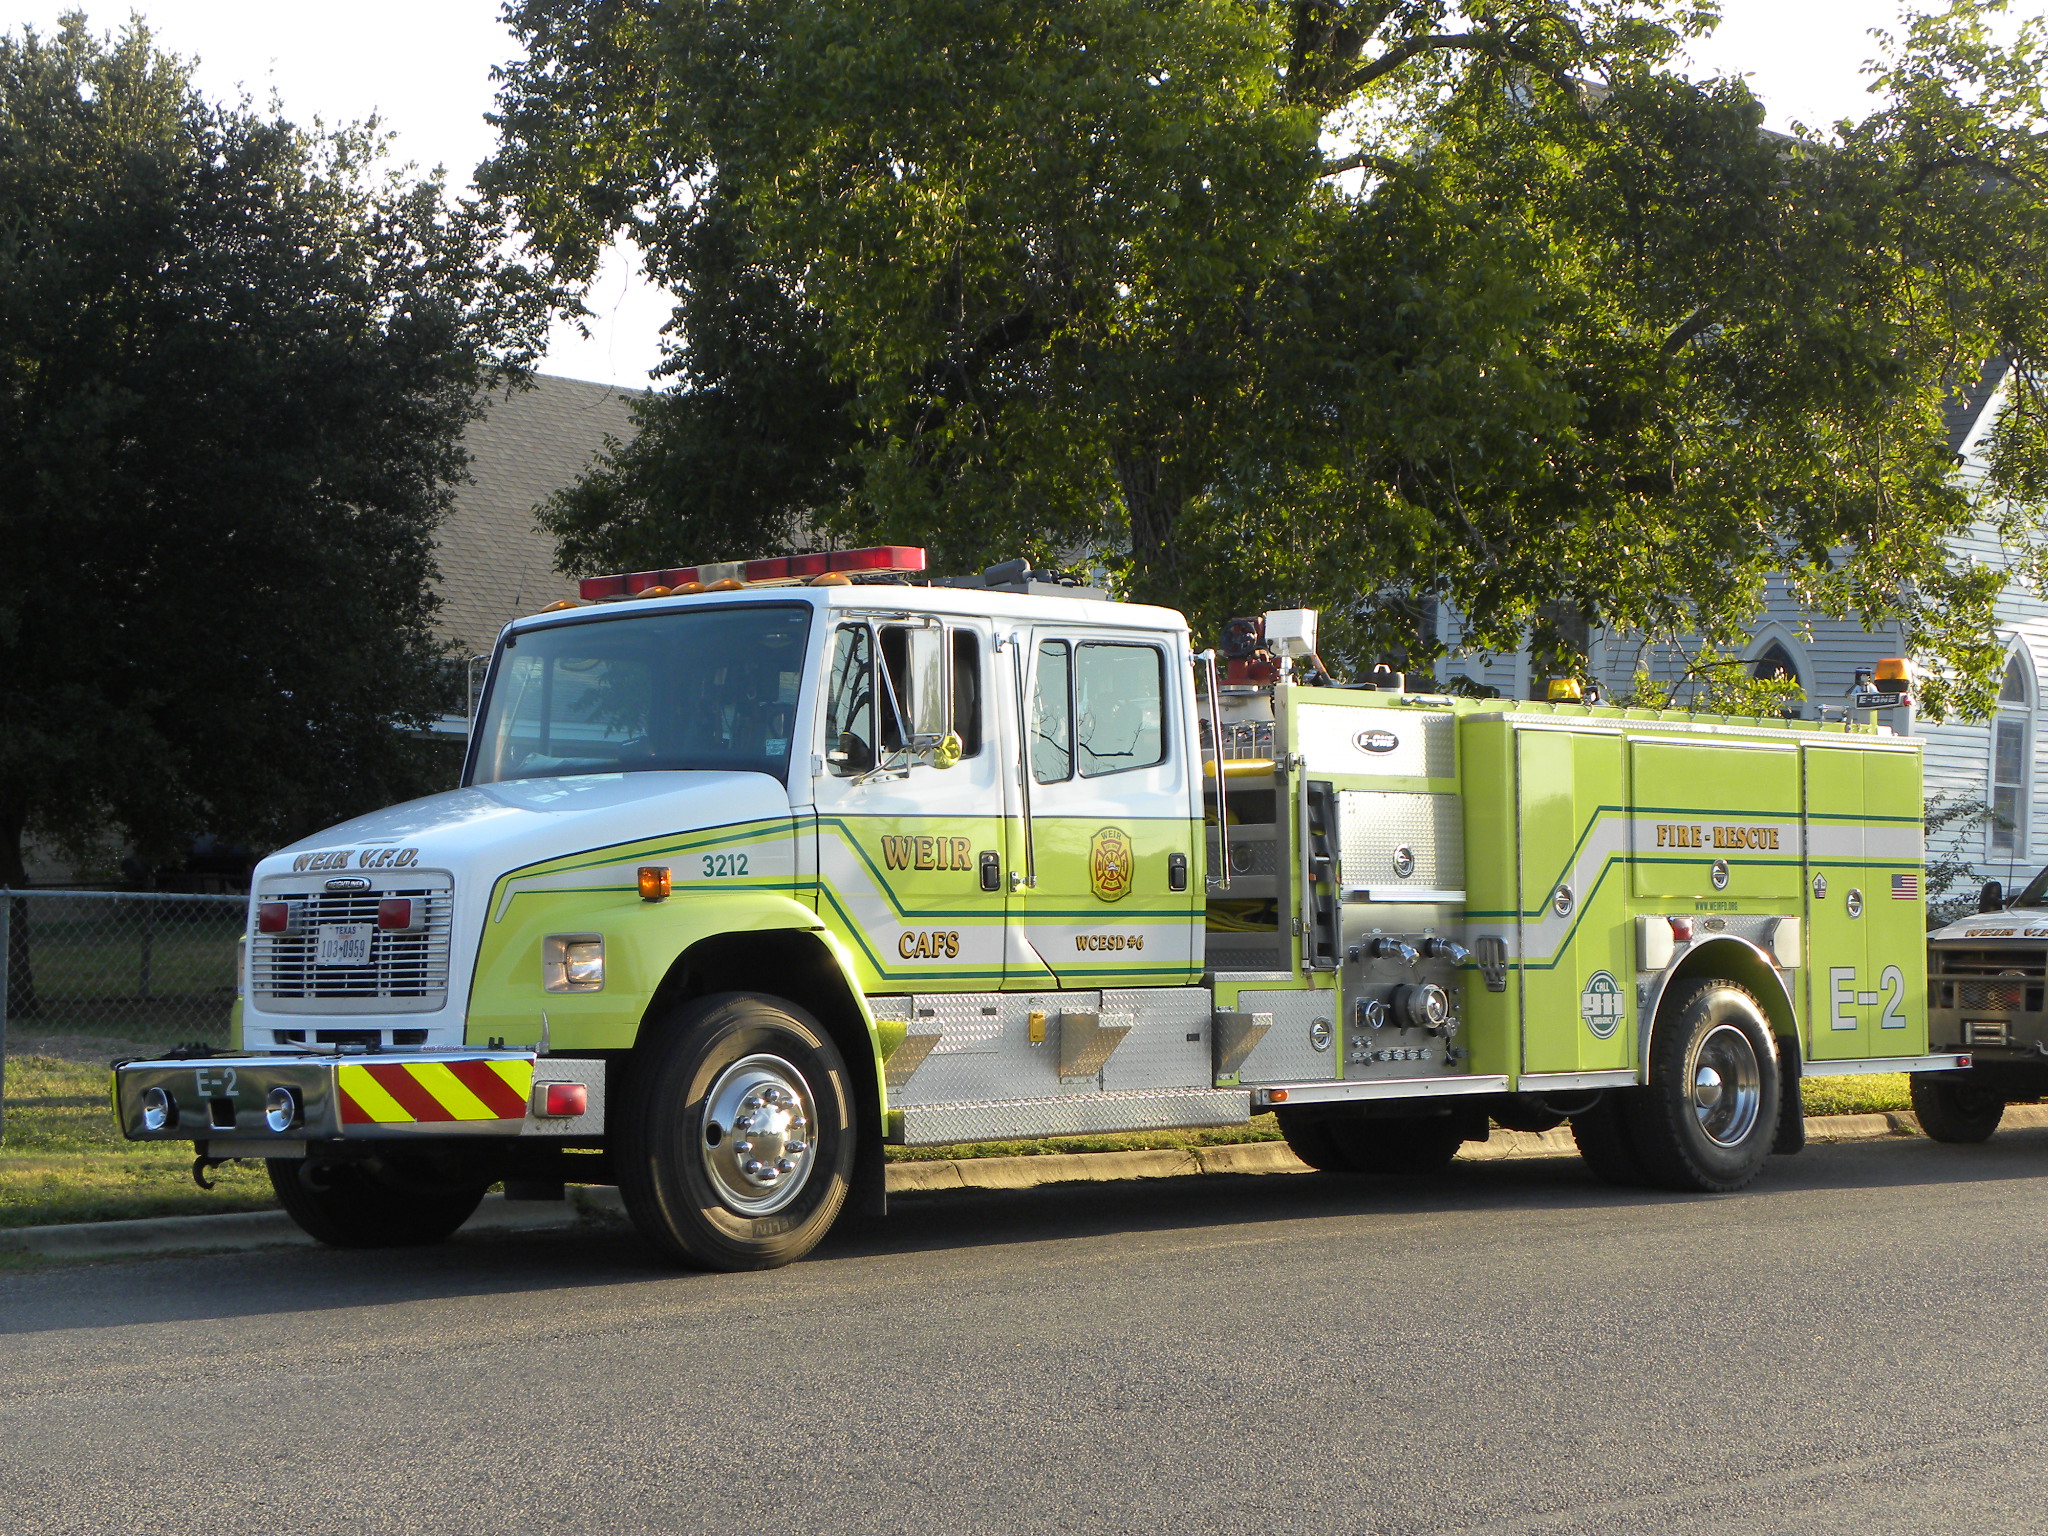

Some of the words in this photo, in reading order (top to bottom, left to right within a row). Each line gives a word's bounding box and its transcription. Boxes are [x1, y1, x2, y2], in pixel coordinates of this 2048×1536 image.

[1858, 695, 1896, 704] E-ONE
[1101, 830, 1121, 840] WEIR
[293, 849, 355, 872] WEIR
[359, 848, 419, 868] V.F.D.
[702, 853, 749, 877] 3212
[881, 835, 972, 871] WEIR
[335, 926, 356, 935] TEXAS
[1964, 928, 2018, 937] WEIR
[898, 931, 960, 959] CAFS
[1595, 981, 1610, 992] CALL
[1829, 964, 1906, 1031] E-2
[1582, 992, 1624, 1016] 911
[195, 1066, 240, 1097] E-2
